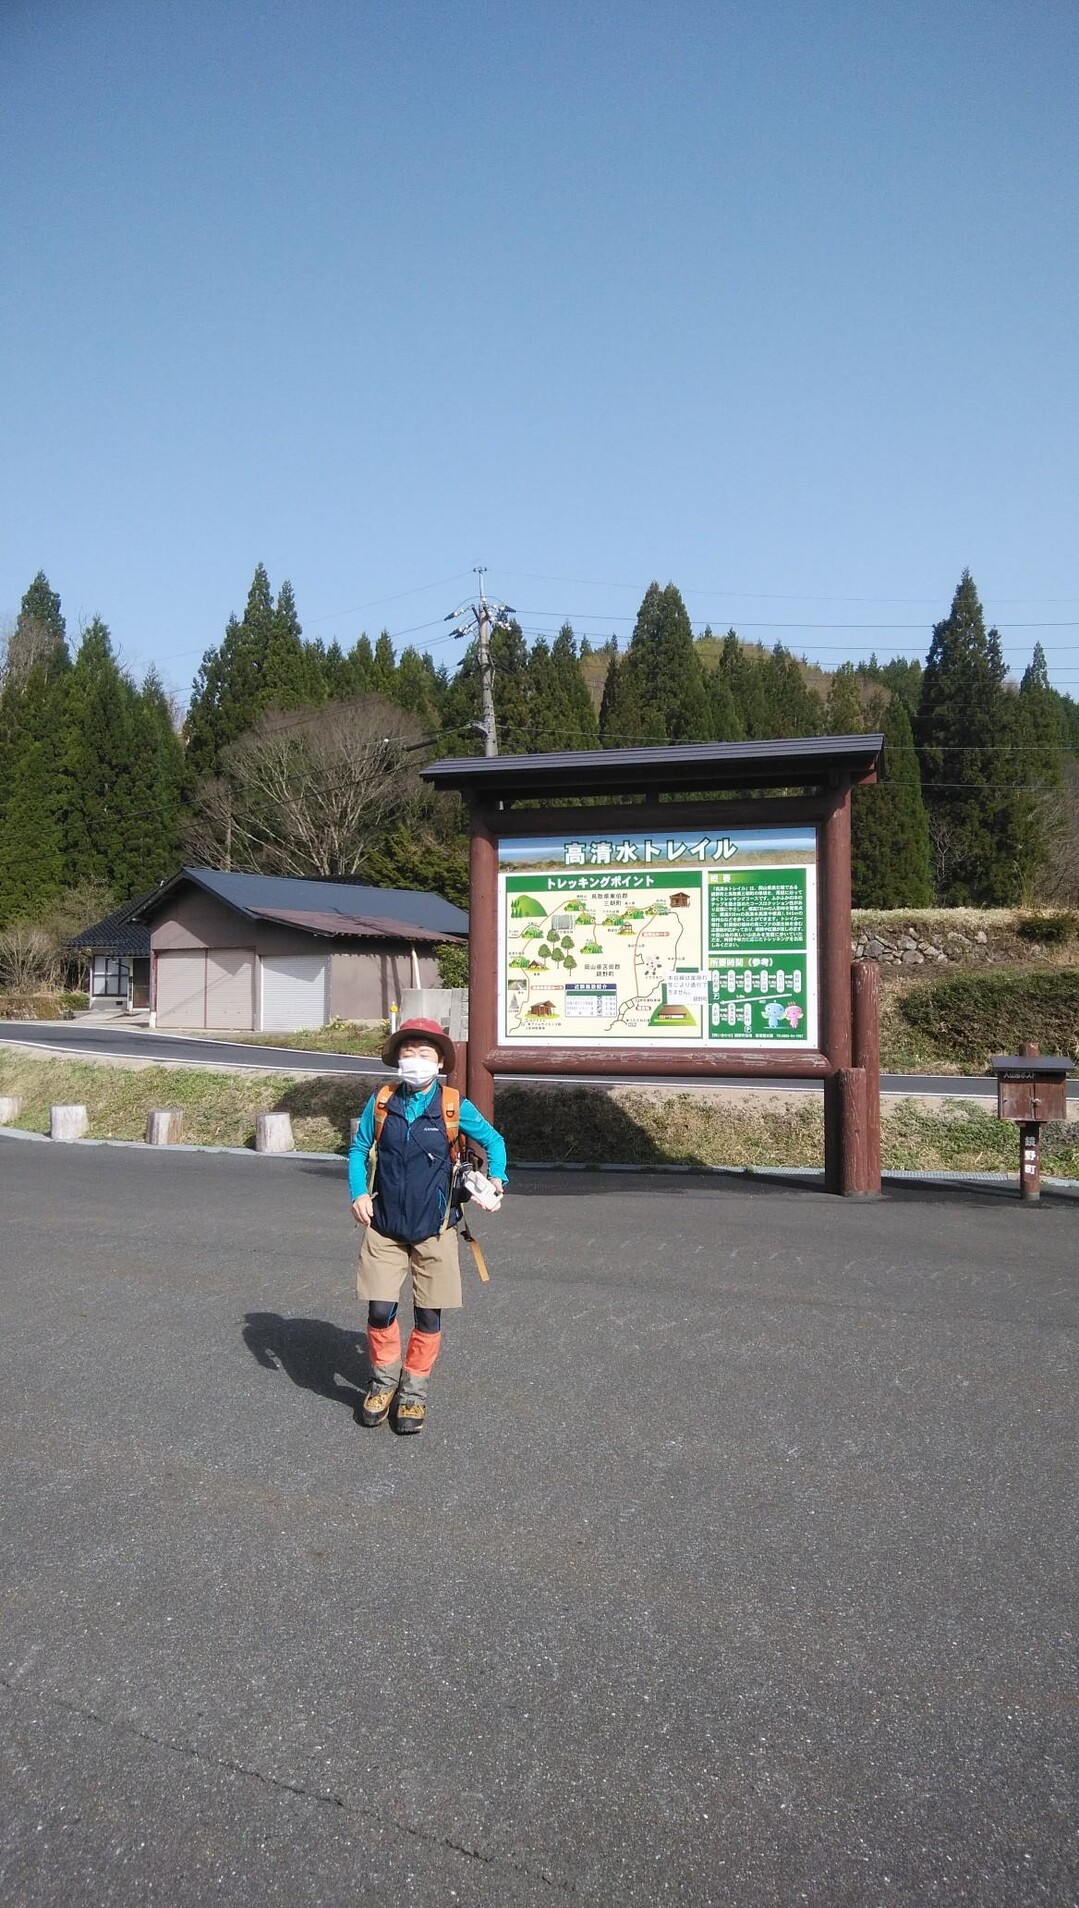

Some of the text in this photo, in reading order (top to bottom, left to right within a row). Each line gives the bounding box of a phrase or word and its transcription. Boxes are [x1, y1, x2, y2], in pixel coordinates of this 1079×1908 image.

[564, 837, 738, 865] 高清水トレイル
[547, 875, 654, 890] トレッキングポイント
[1024, 1136, 1037, 1175] 鏡野町
